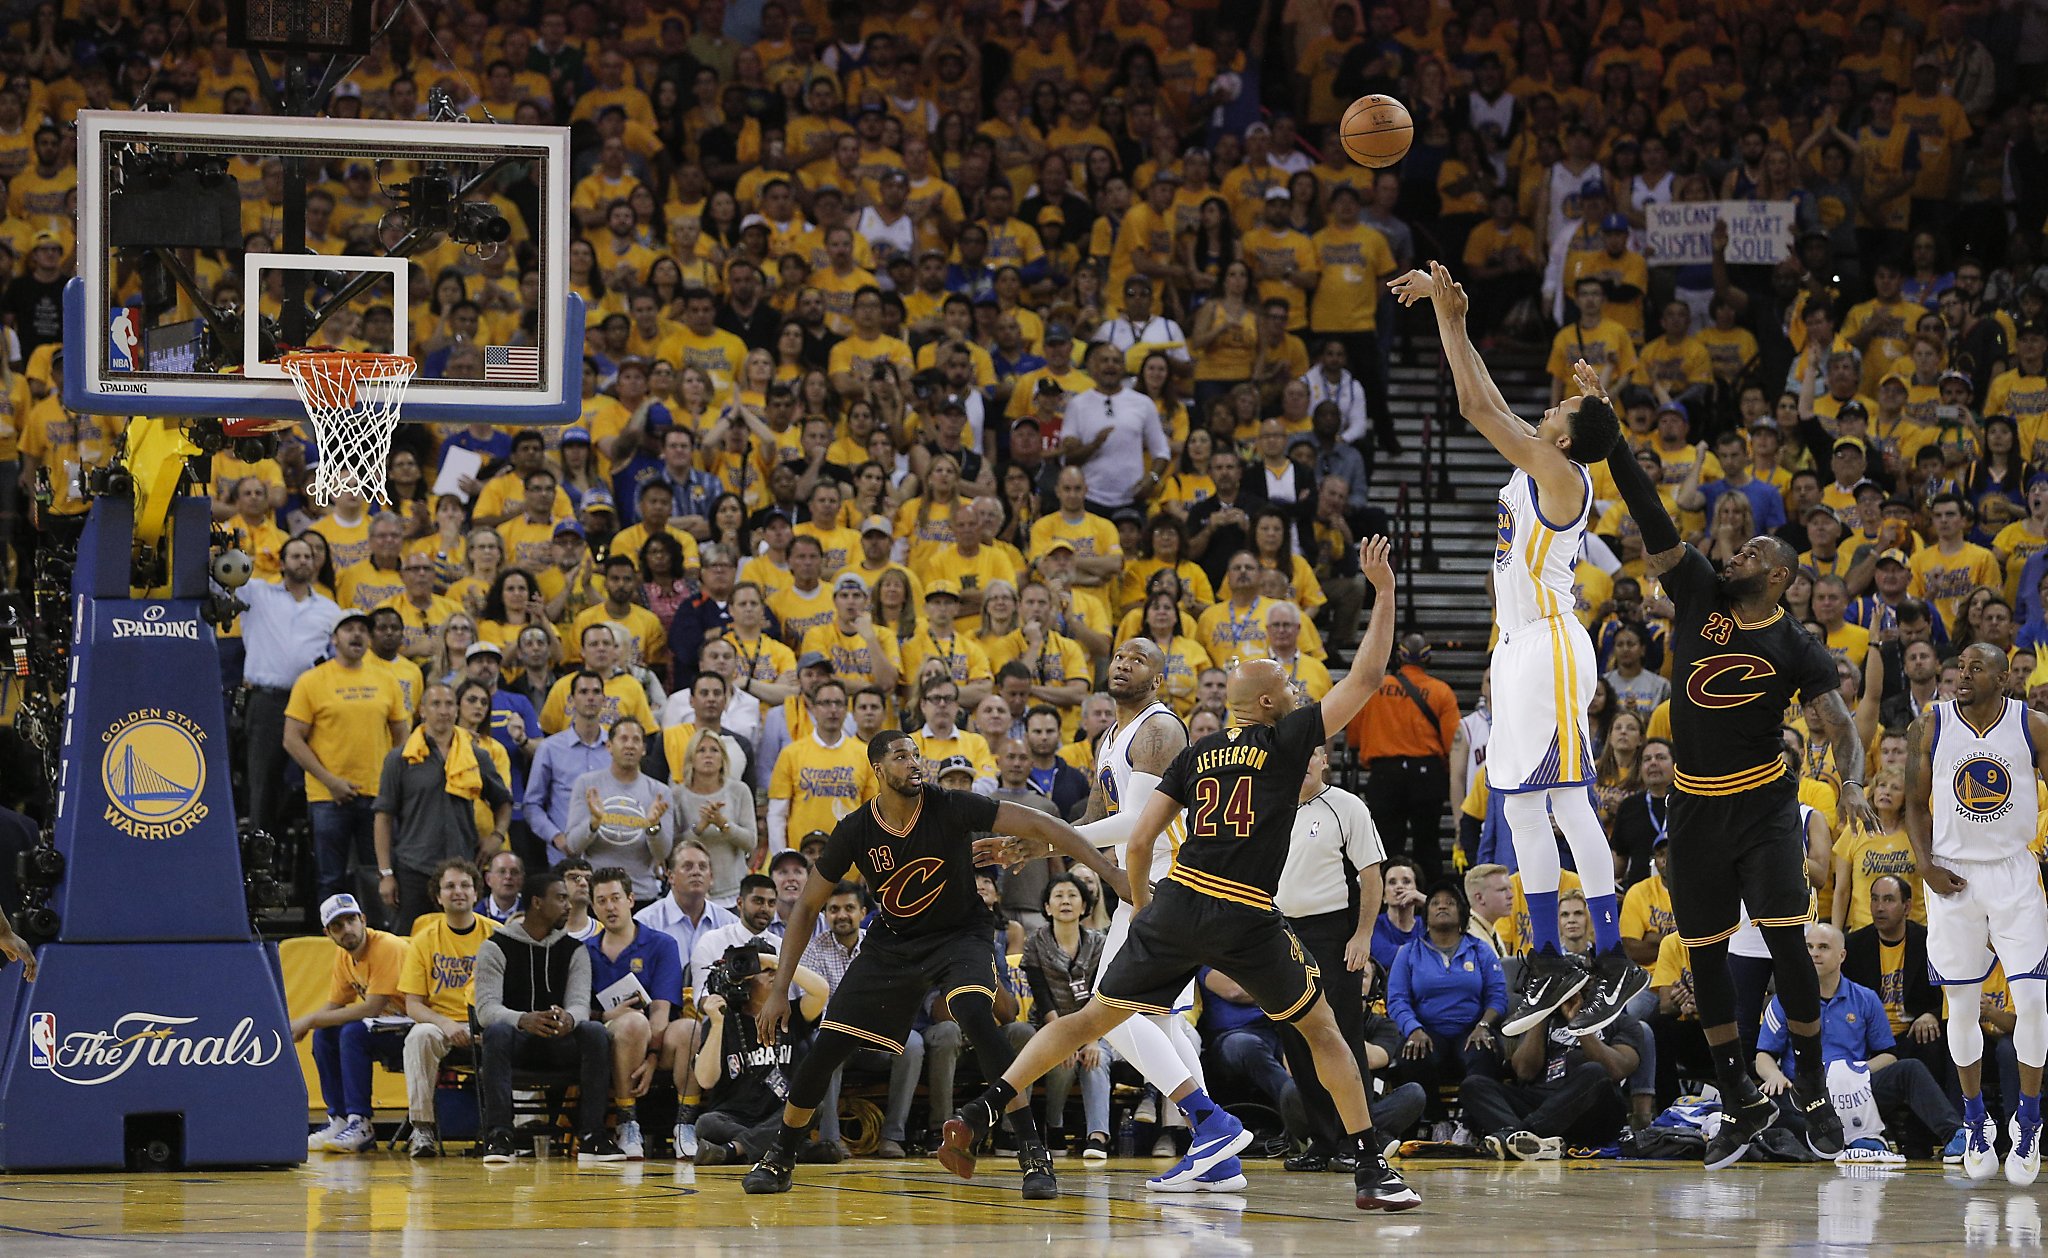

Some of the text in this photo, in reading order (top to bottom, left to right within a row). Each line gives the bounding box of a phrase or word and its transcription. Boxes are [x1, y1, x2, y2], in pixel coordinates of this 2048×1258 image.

[1656, 207, 1681, 227] YOU
[1731, 216, 1782, 235] HEART
[1650, 231, 1713, 259] SUSPEN
[1730, 237, 1779, 261] SOUL
[112, 358, 130, 368] NBA
[100, 383, 148, 394] SPALDING
[1501, 494, 1518, 513] STATE
[1497, 512, 1511, 530] 34
[112, 618, 200, 640] SPALDING
[1700, 612, 1734, 645] 23
[102, 708, 208, 743] GOLDEN STATE
[1196, 745, 1268, 774] JEFFERSON
[1952, 751, 2012, 771] GOLDEN STATE
[1987, 769, 1998, 784] 9
[1194, 776, 1255, 838] 24
[1955, 801, 2014, 823] WARRIORS
[103, 801, 210, 841] WARRIORS
[868, 845, 895, 873] 13
[50, 1012, 282, 1085] The Finals
